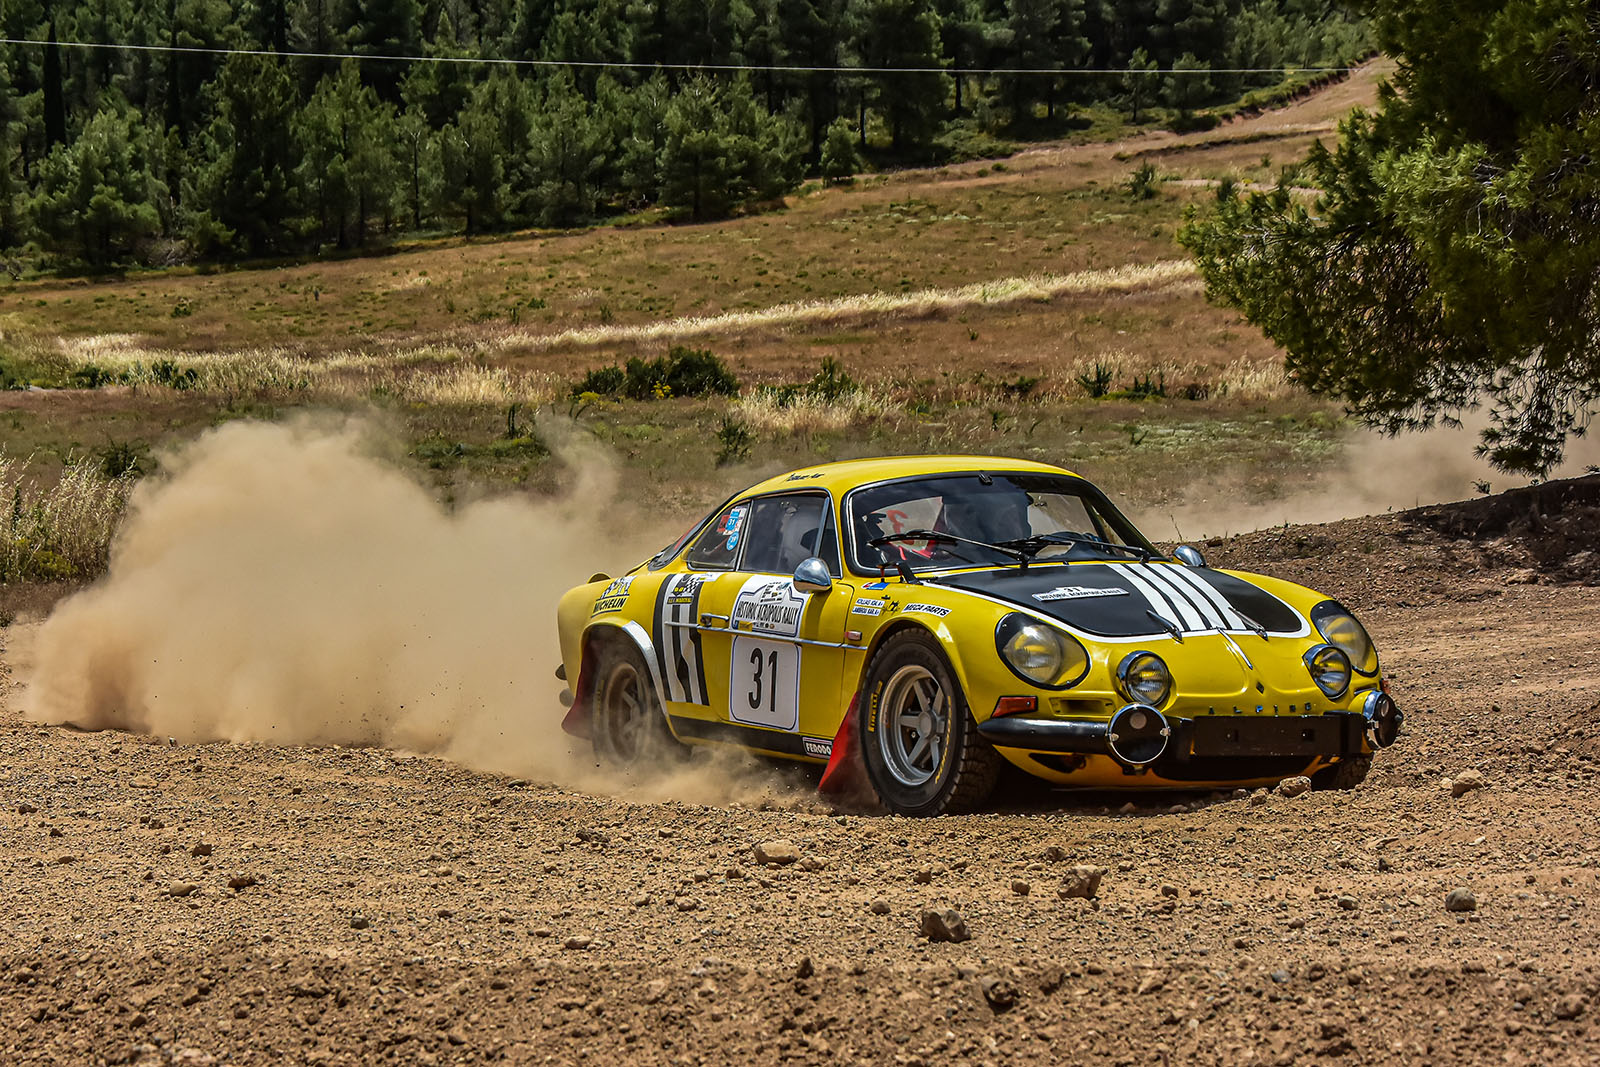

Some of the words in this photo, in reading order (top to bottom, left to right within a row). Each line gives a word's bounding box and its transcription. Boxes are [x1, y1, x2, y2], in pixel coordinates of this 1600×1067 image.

[593, 597, 627, 614] MICHELIN
[736, 600, 758, 620] HISTORIC
[756, 603, 784, 623] ACROPOLIS
[782, 606, 799, 625] RALLY
[904, 603, 921, 611] MEGA
[922, 605, 949, 616] PARTS
[748, 647, 778, 712] 31
[805, 743, 832, 756] FERODO
